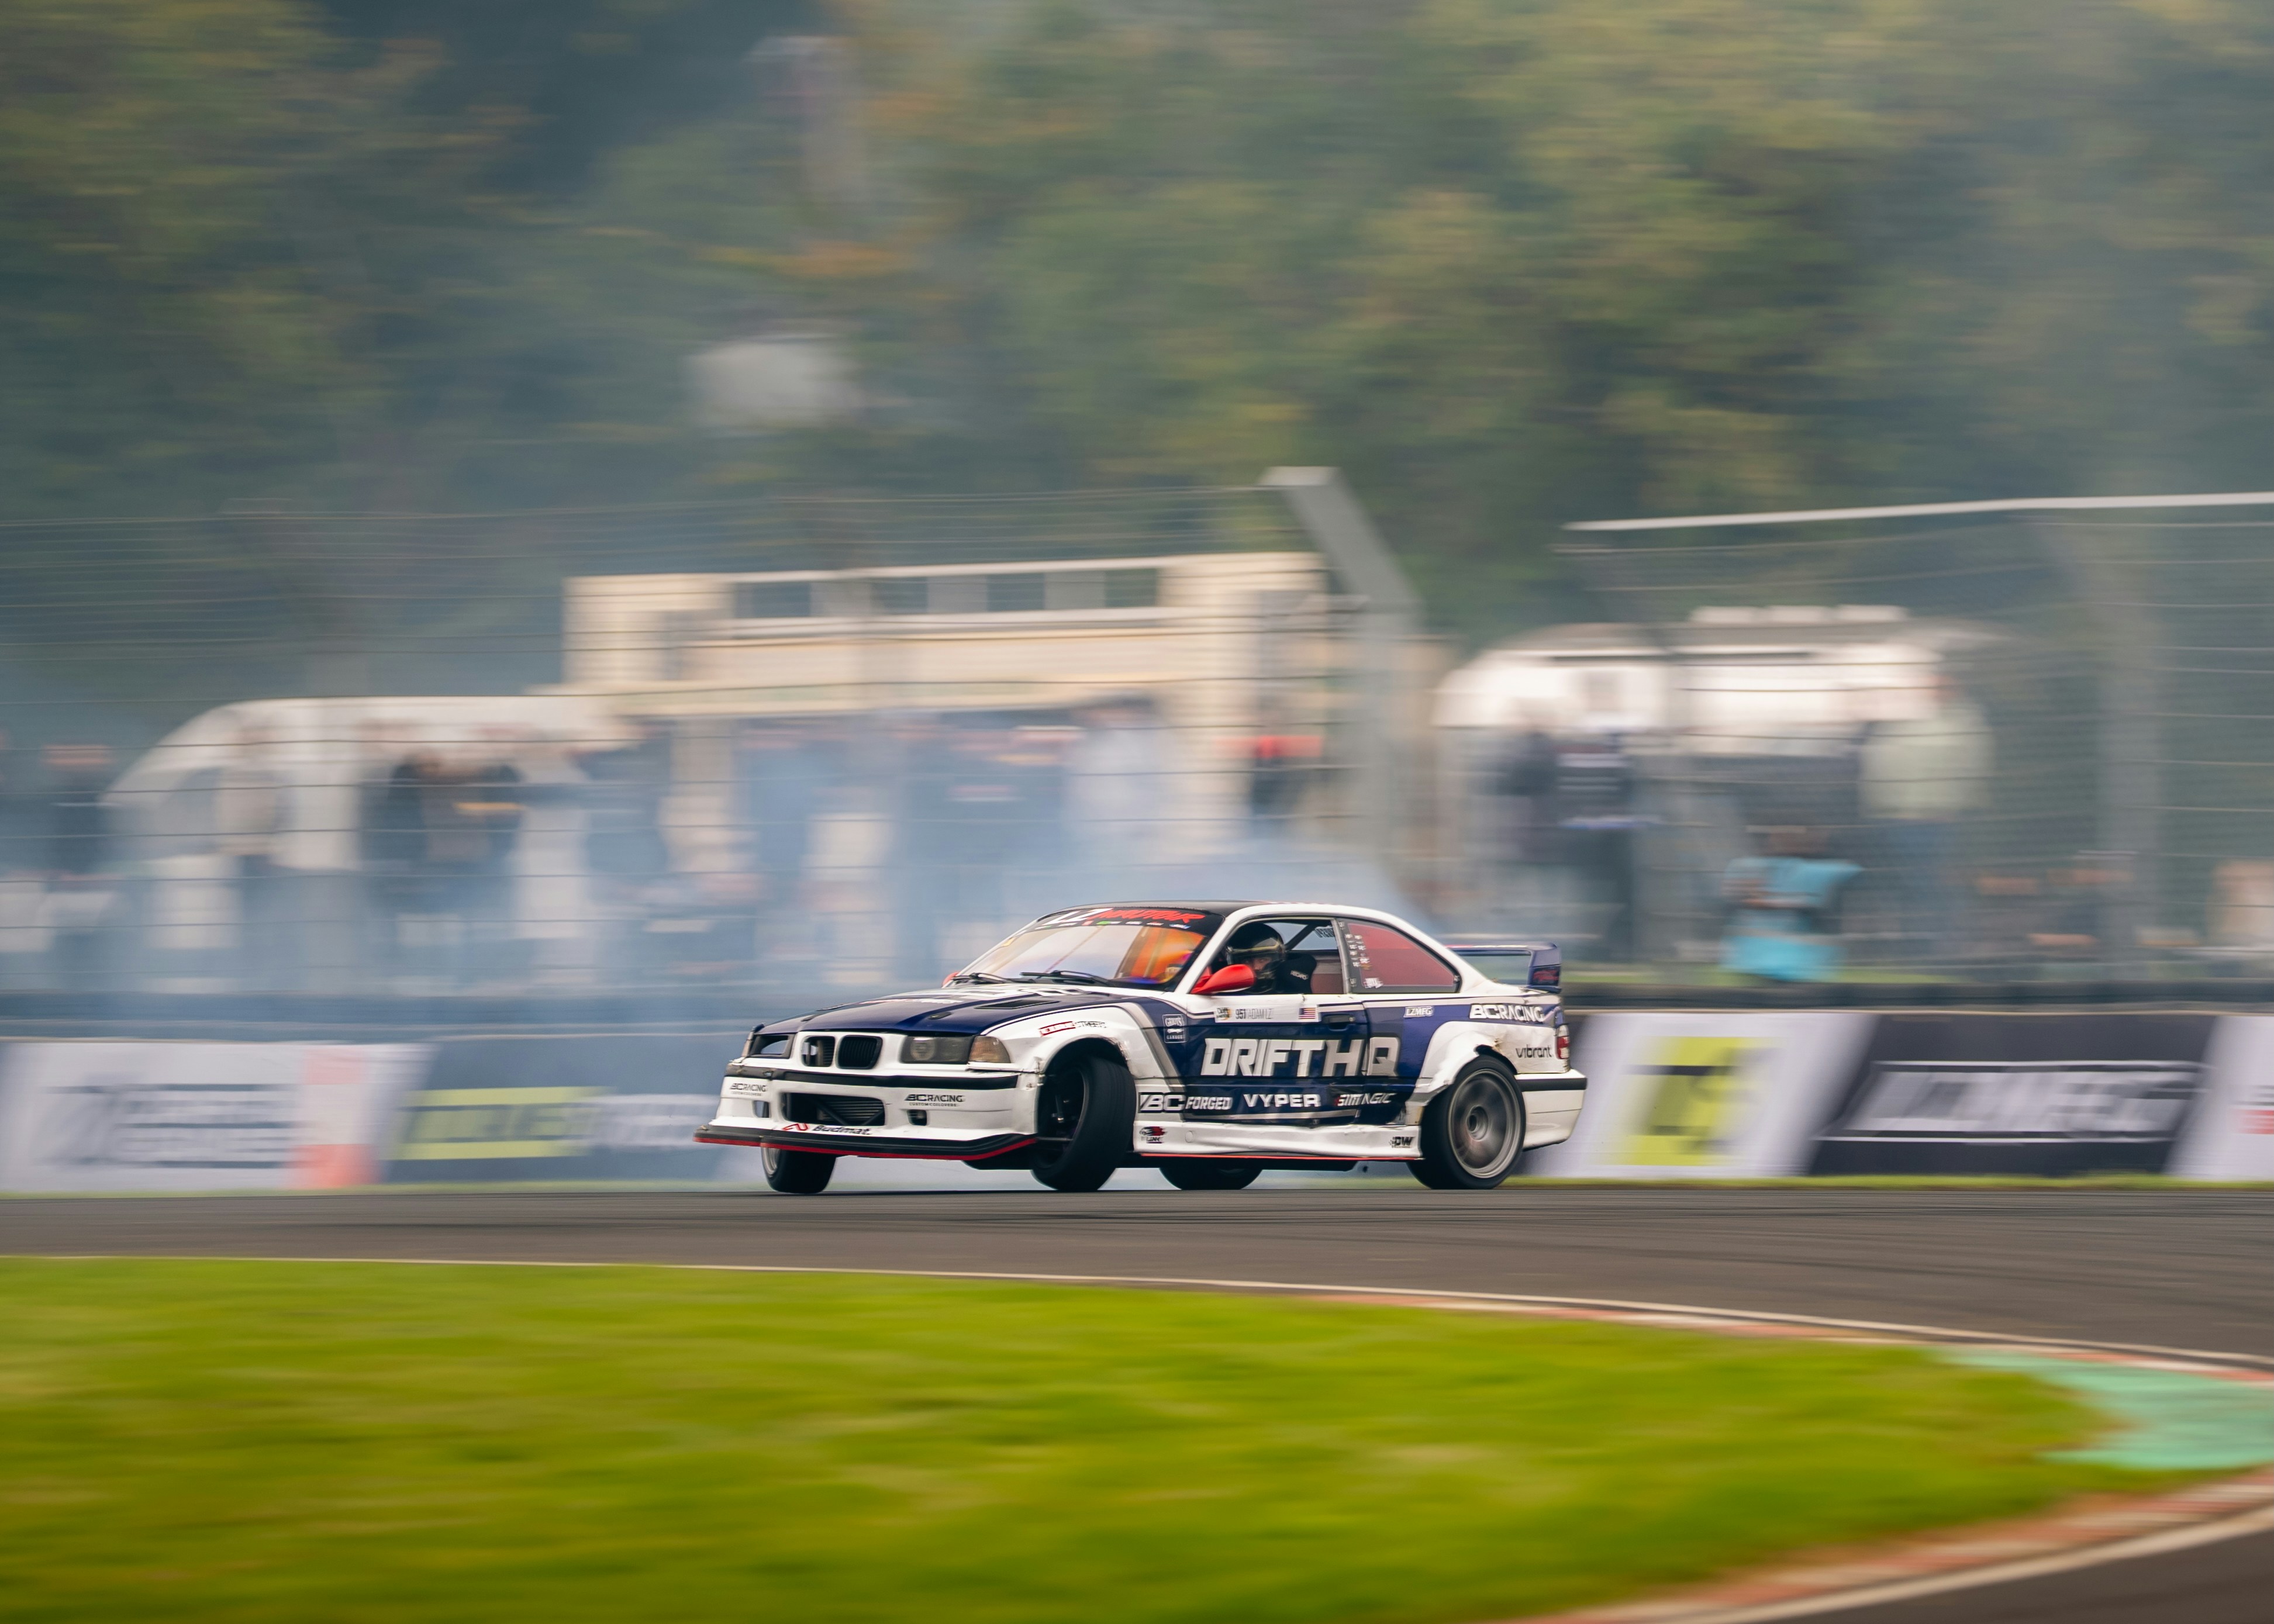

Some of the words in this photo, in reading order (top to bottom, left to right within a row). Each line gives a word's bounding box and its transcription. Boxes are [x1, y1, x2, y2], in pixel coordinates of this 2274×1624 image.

[1235, 1008, 1246, 1020] 951
[1247, 1008, 1264, 1020] ADAM
[1265, 1008, 1275, 1020] LZ
[1516, 1044, 1553, 1058] vibrant
[1185, 1096, 1233, 1110] FORGED
[1243, 1094, 1321, 1107] VYPER
[1337, 1093, 1397, 1107] SIMAGIC
